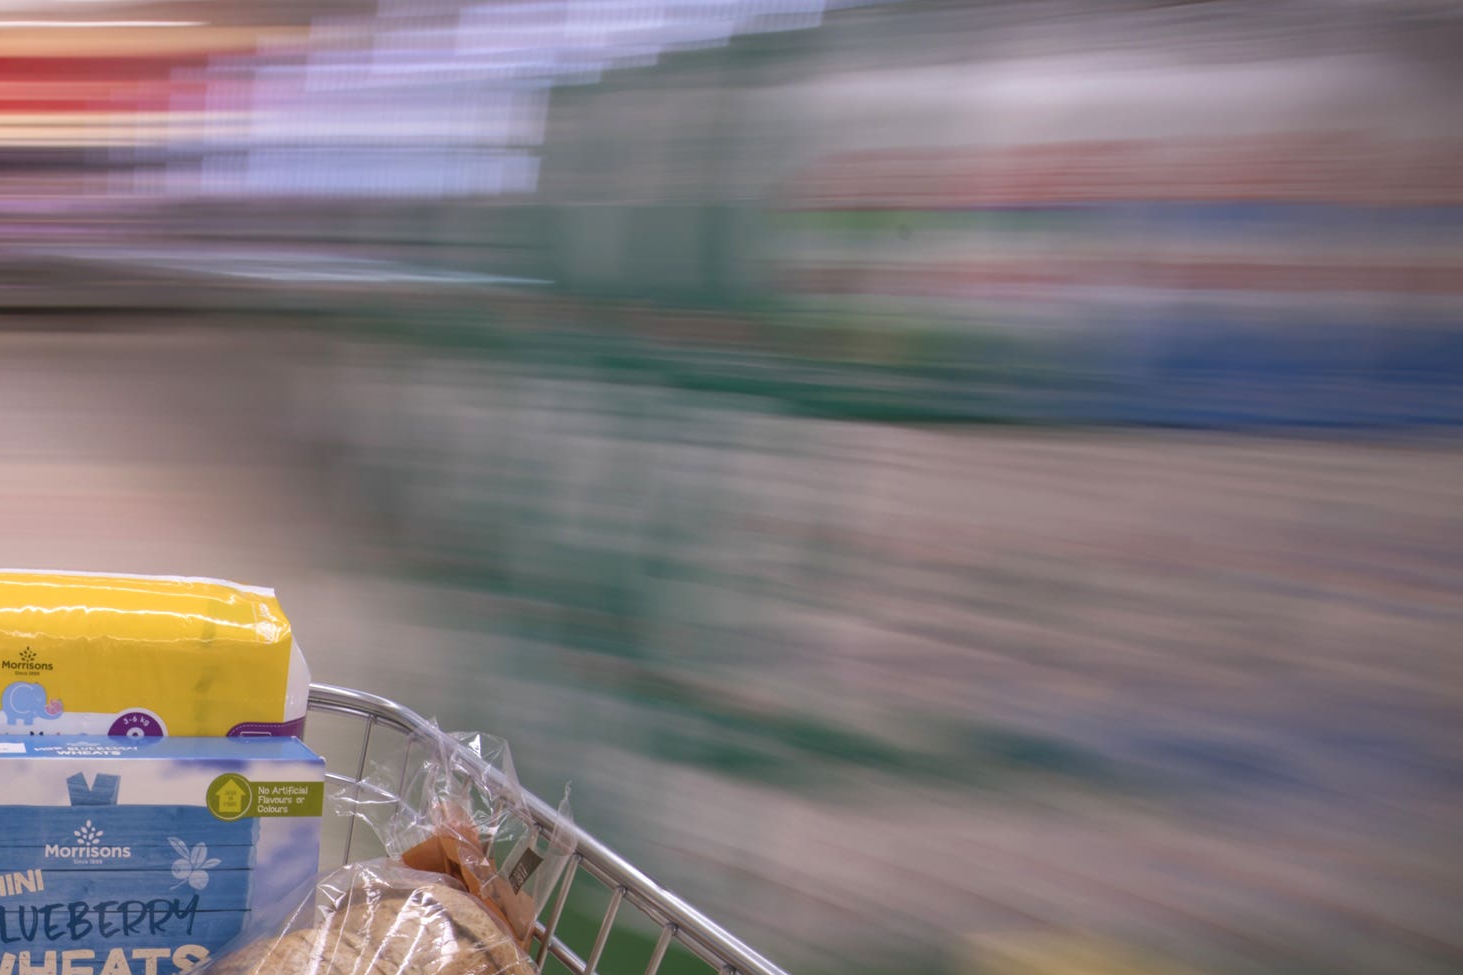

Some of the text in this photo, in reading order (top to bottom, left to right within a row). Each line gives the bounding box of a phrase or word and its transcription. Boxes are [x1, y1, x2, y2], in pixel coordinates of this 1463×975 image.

[1, 660, 54, 671] Morrisons
[258, 786, 308, 795] No Artificial
[258, 796, 293, 804] Flavours
[257, 805, 289, 813] Colours
[44, 843, 131, 858] Morrisons
